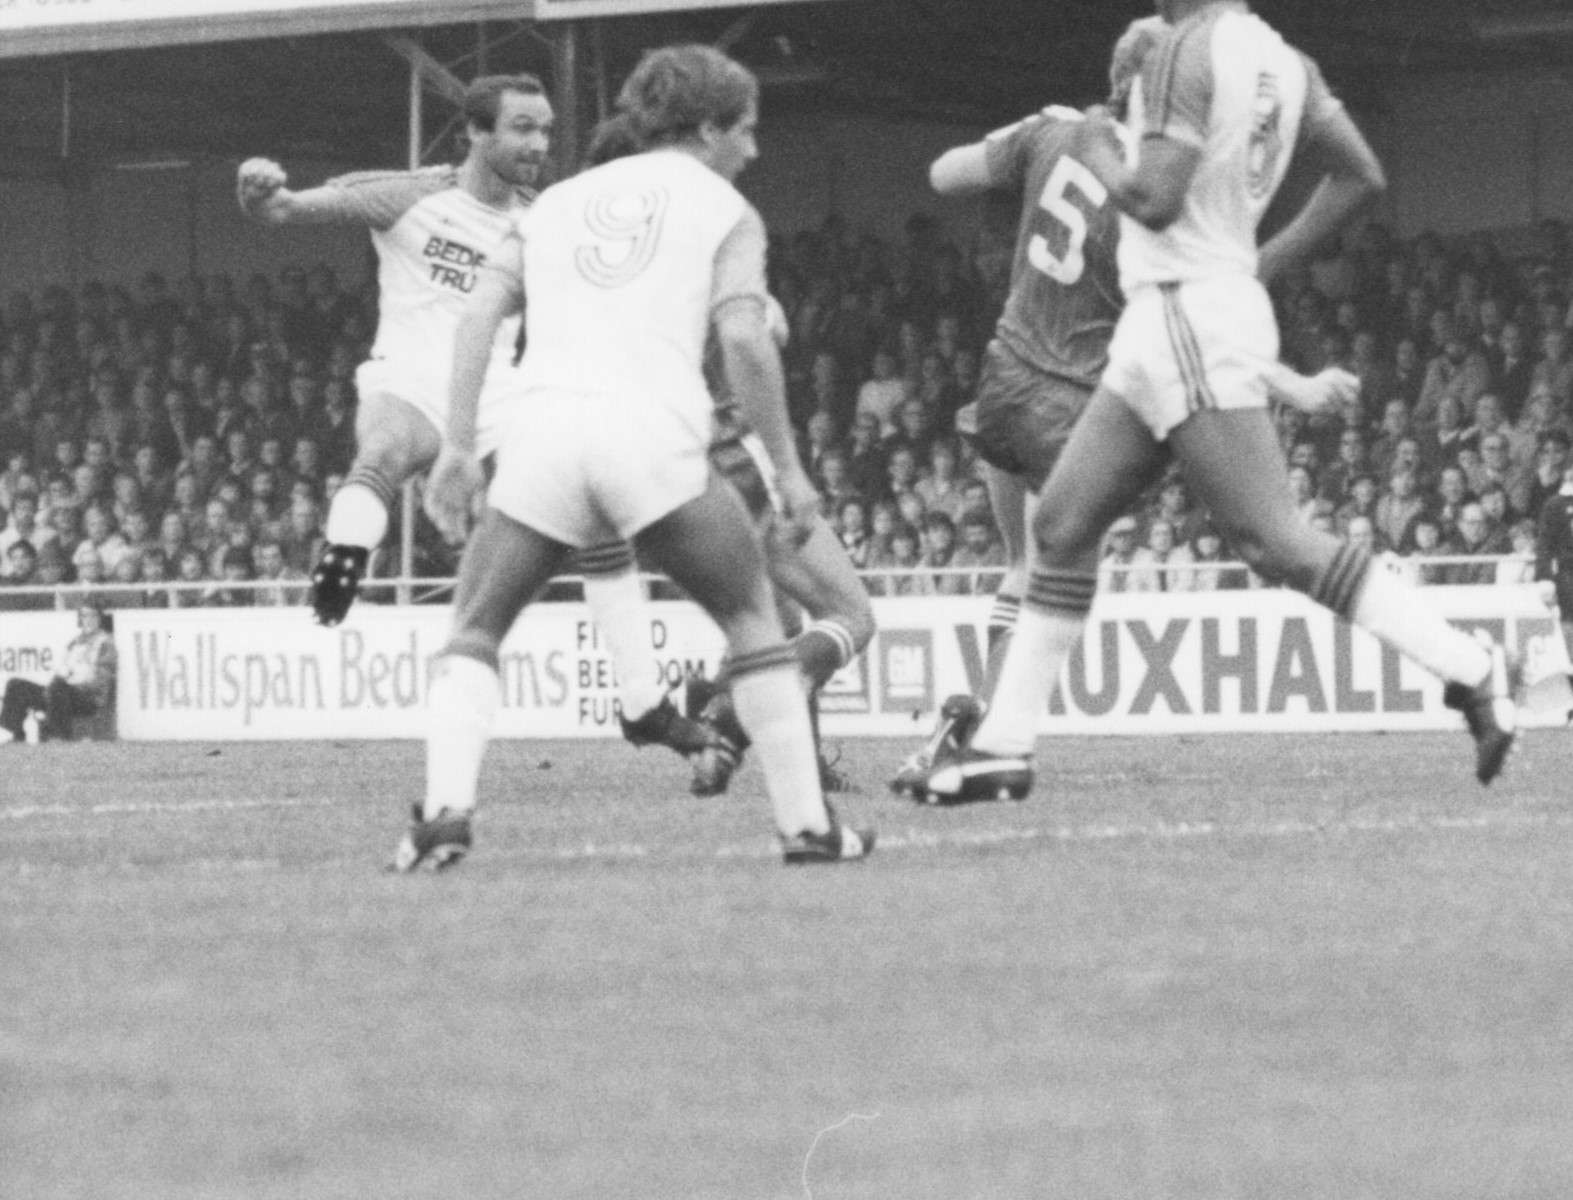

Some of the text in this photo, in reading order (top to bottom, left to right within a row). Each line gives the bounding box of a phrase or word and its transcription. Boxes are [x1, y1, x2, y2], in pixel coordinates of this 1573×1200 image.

[574, 182, 669, 289] 9
[1028, 155, 1107, 285] 5
[0, 646, 53, 672] ame
[133, 628, 569, 725] Wallspan Bedms
[577, 621, 667, 650] FID
[955, 616, 1423, 716] VUXHALL
